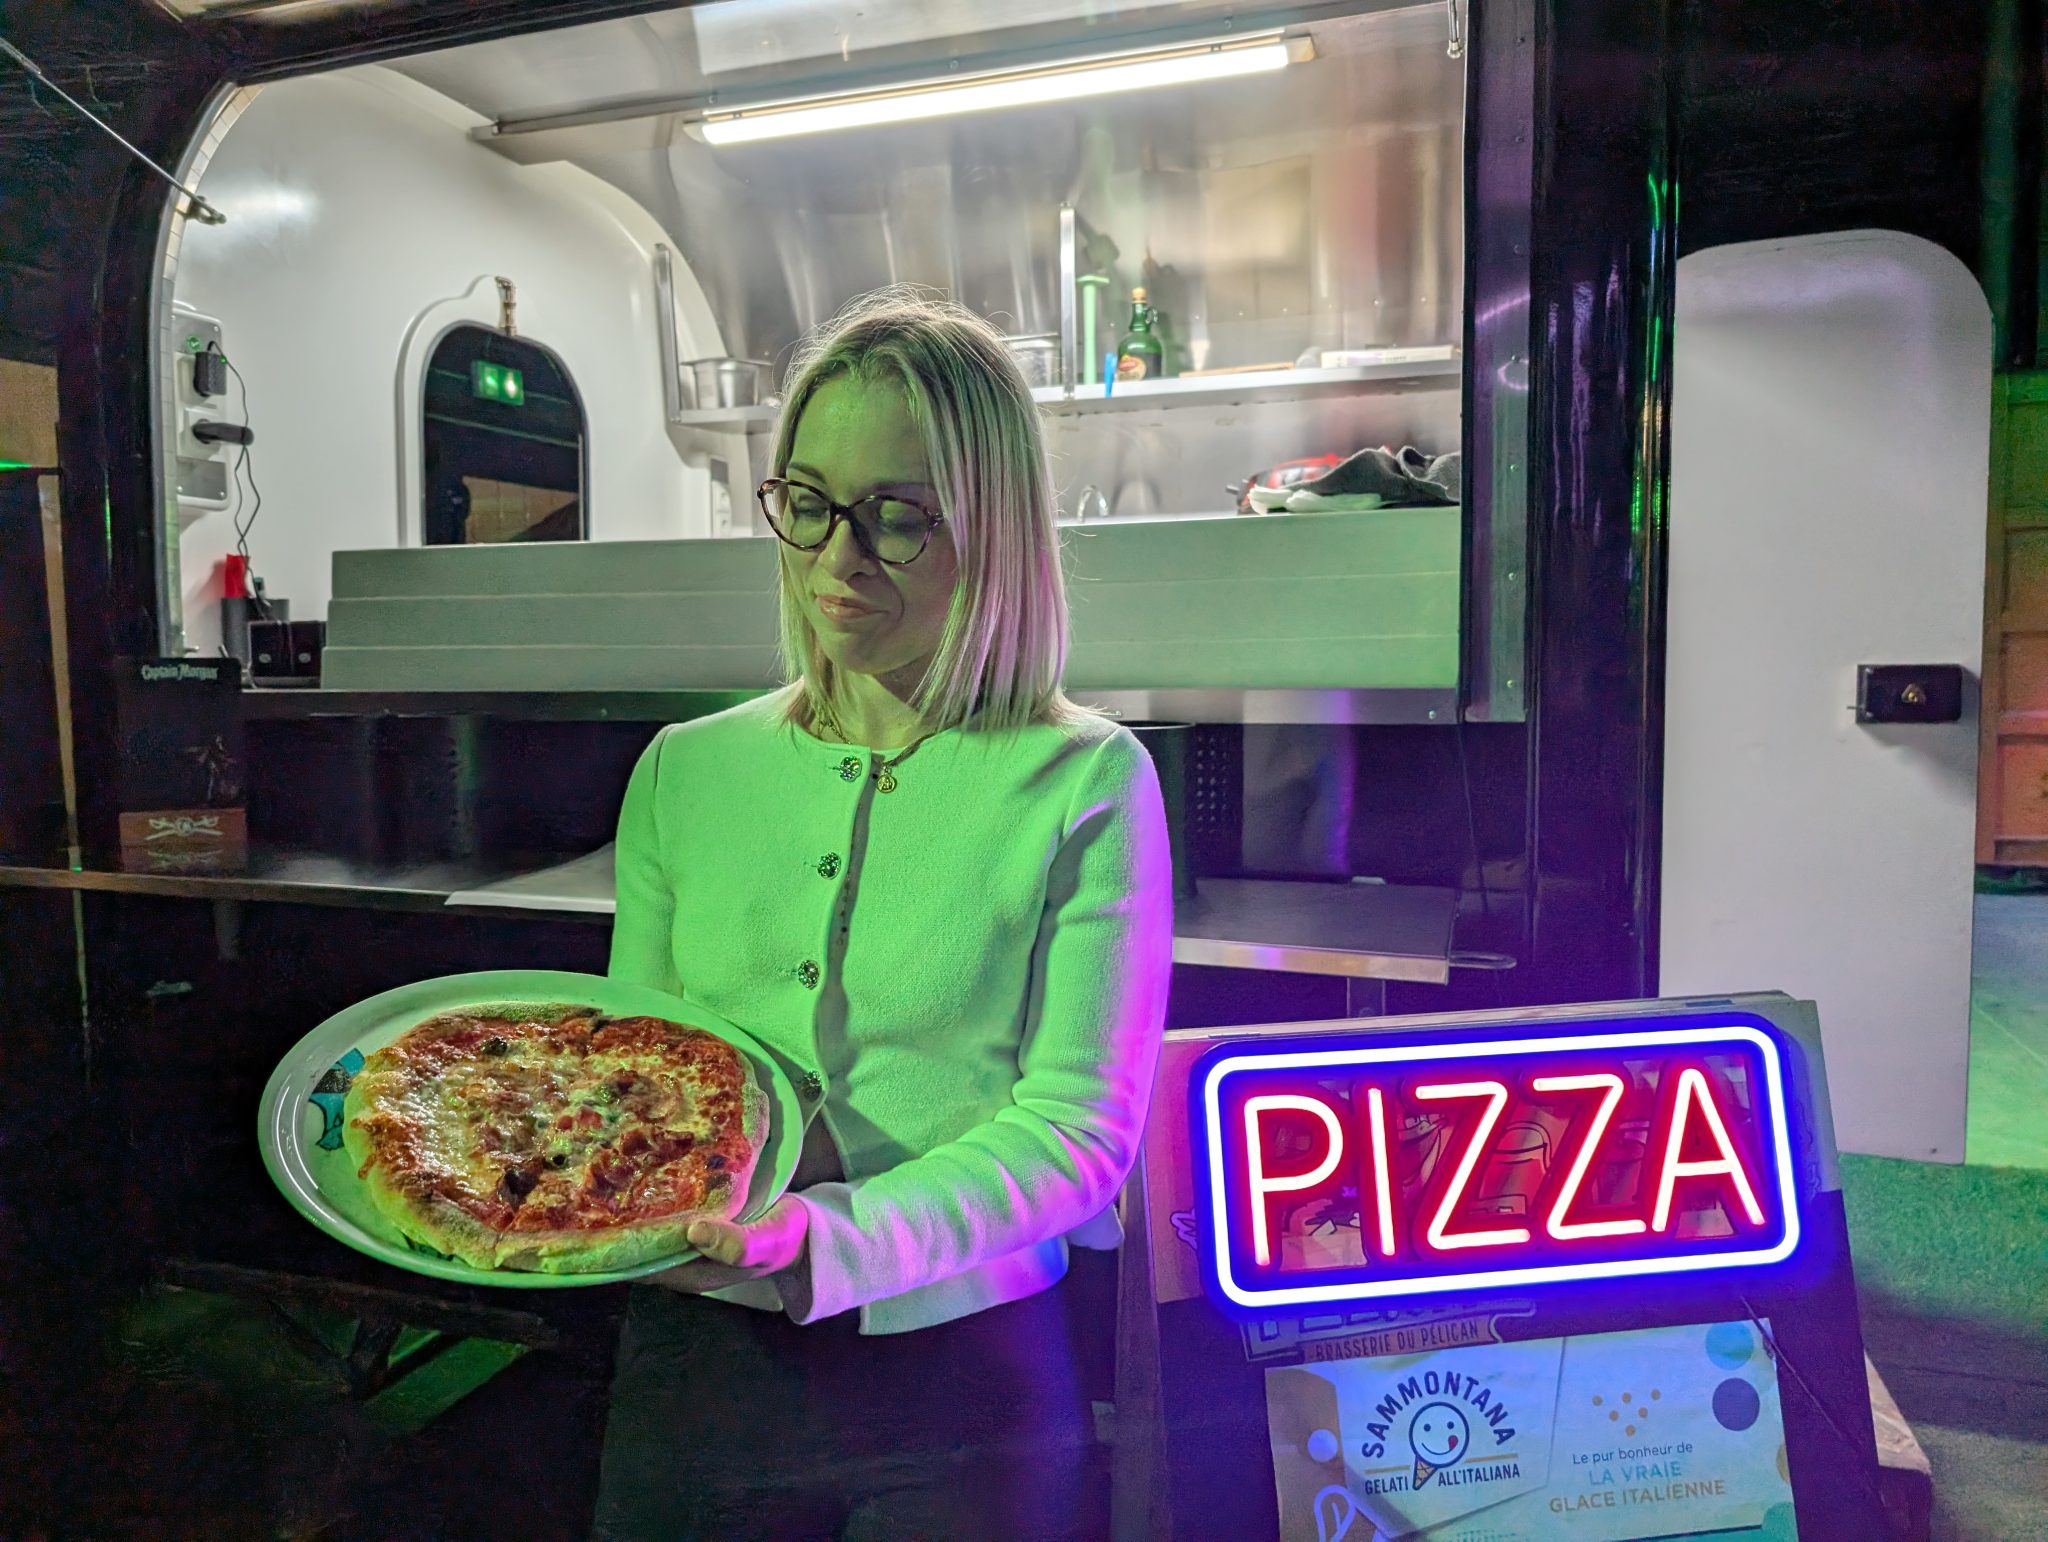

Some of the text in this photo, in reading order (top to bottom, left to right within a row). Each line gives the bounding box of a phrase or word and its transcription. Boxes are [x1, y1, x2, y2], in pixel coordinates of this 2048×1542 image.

[1243, 1067, 1766, 1267] PIZZA
[1315, 1334, 1391, 1362] BRASSERIE
[1397, 1330, 1417, 1350] DU
[1420, 1318, 1480, 1347] PÉLICAN
[1361, 1370, 1516, 1459] SAMMONTANA
[1572, 1440, 1694, 1465] Le pur bonheur de
[1364, 1463, 1521, 1496] GELATI ALL'ITALIANA
[1588, 1460, 1683, 1486] LA VRAIE
[1549, 1479, 1727, 1513] GLACE ITALIENNE
